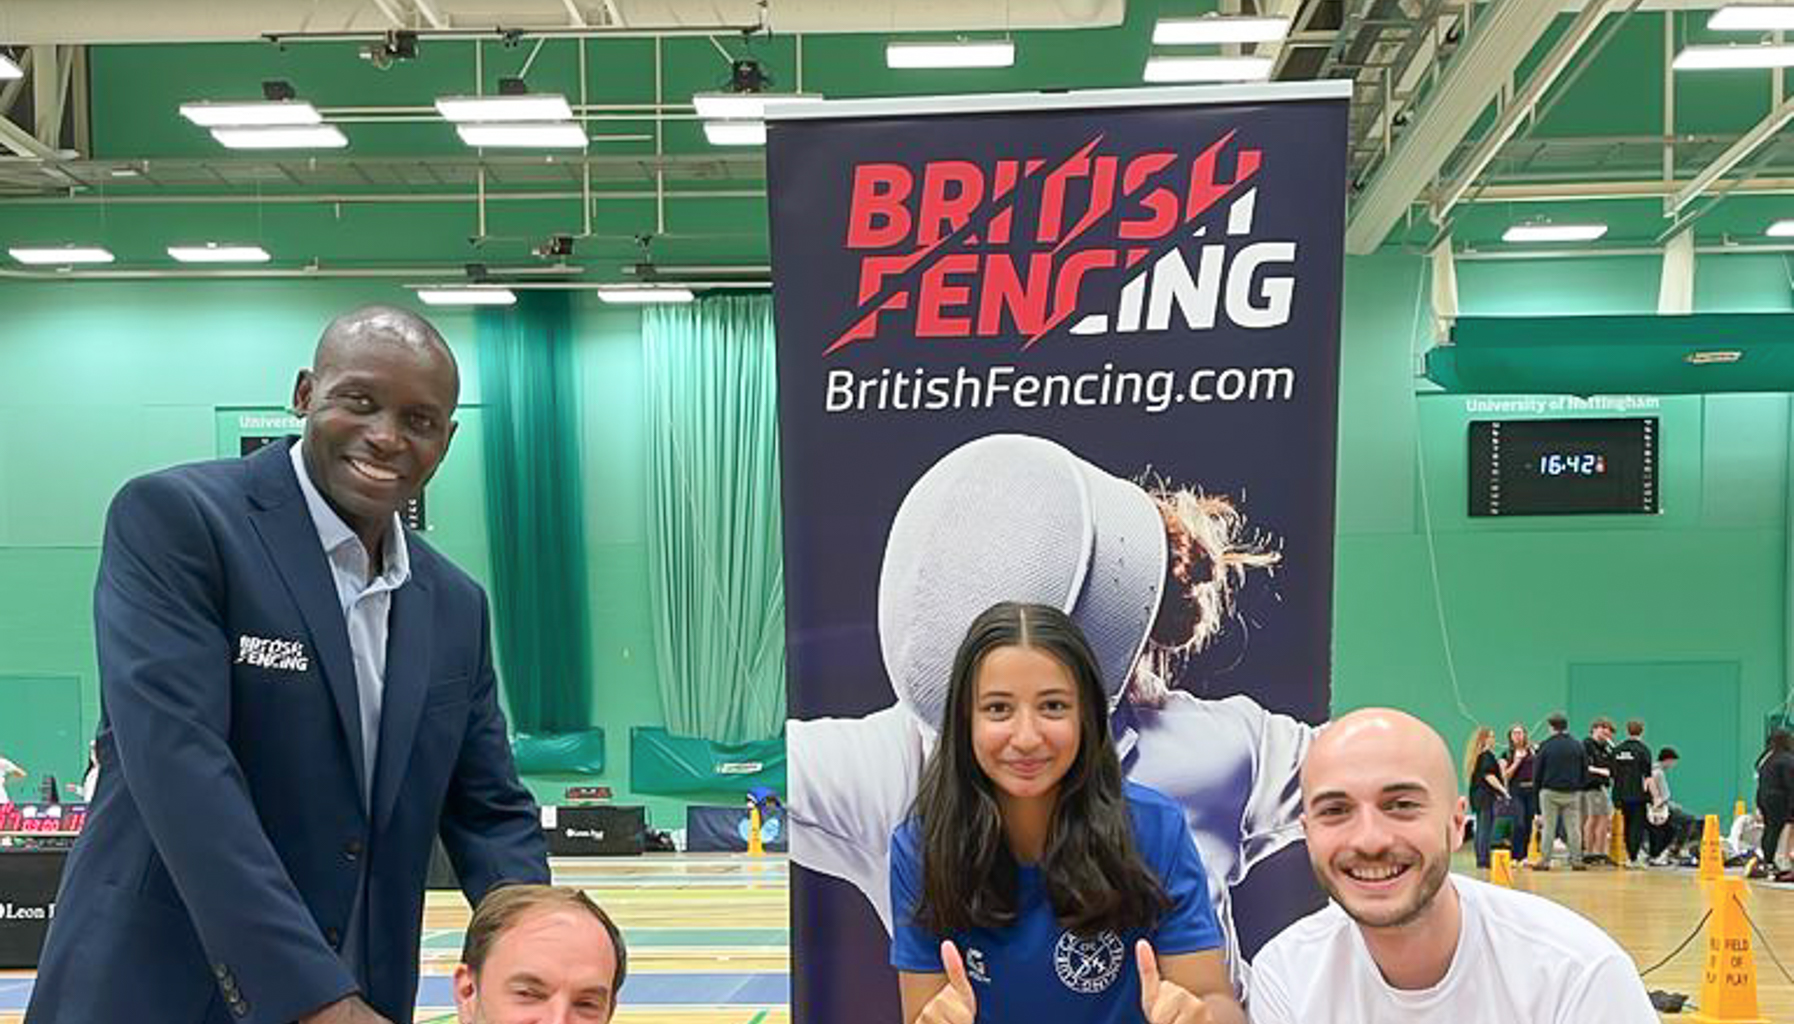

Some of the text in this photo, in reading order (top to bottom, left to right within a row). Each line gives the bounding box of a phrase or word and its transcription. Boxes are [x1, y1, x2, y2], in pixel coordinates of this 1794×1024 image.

[847, 129, 1262, 250] BRITISH
[822, 242, 1296, 356] FENCING
[825, 363, 1295, 412] BritishFencing.com
[1466, 399, 1549, 414] University
[1550, 399, 1565, 411] of
[6, 903, 46, 919] Leon
